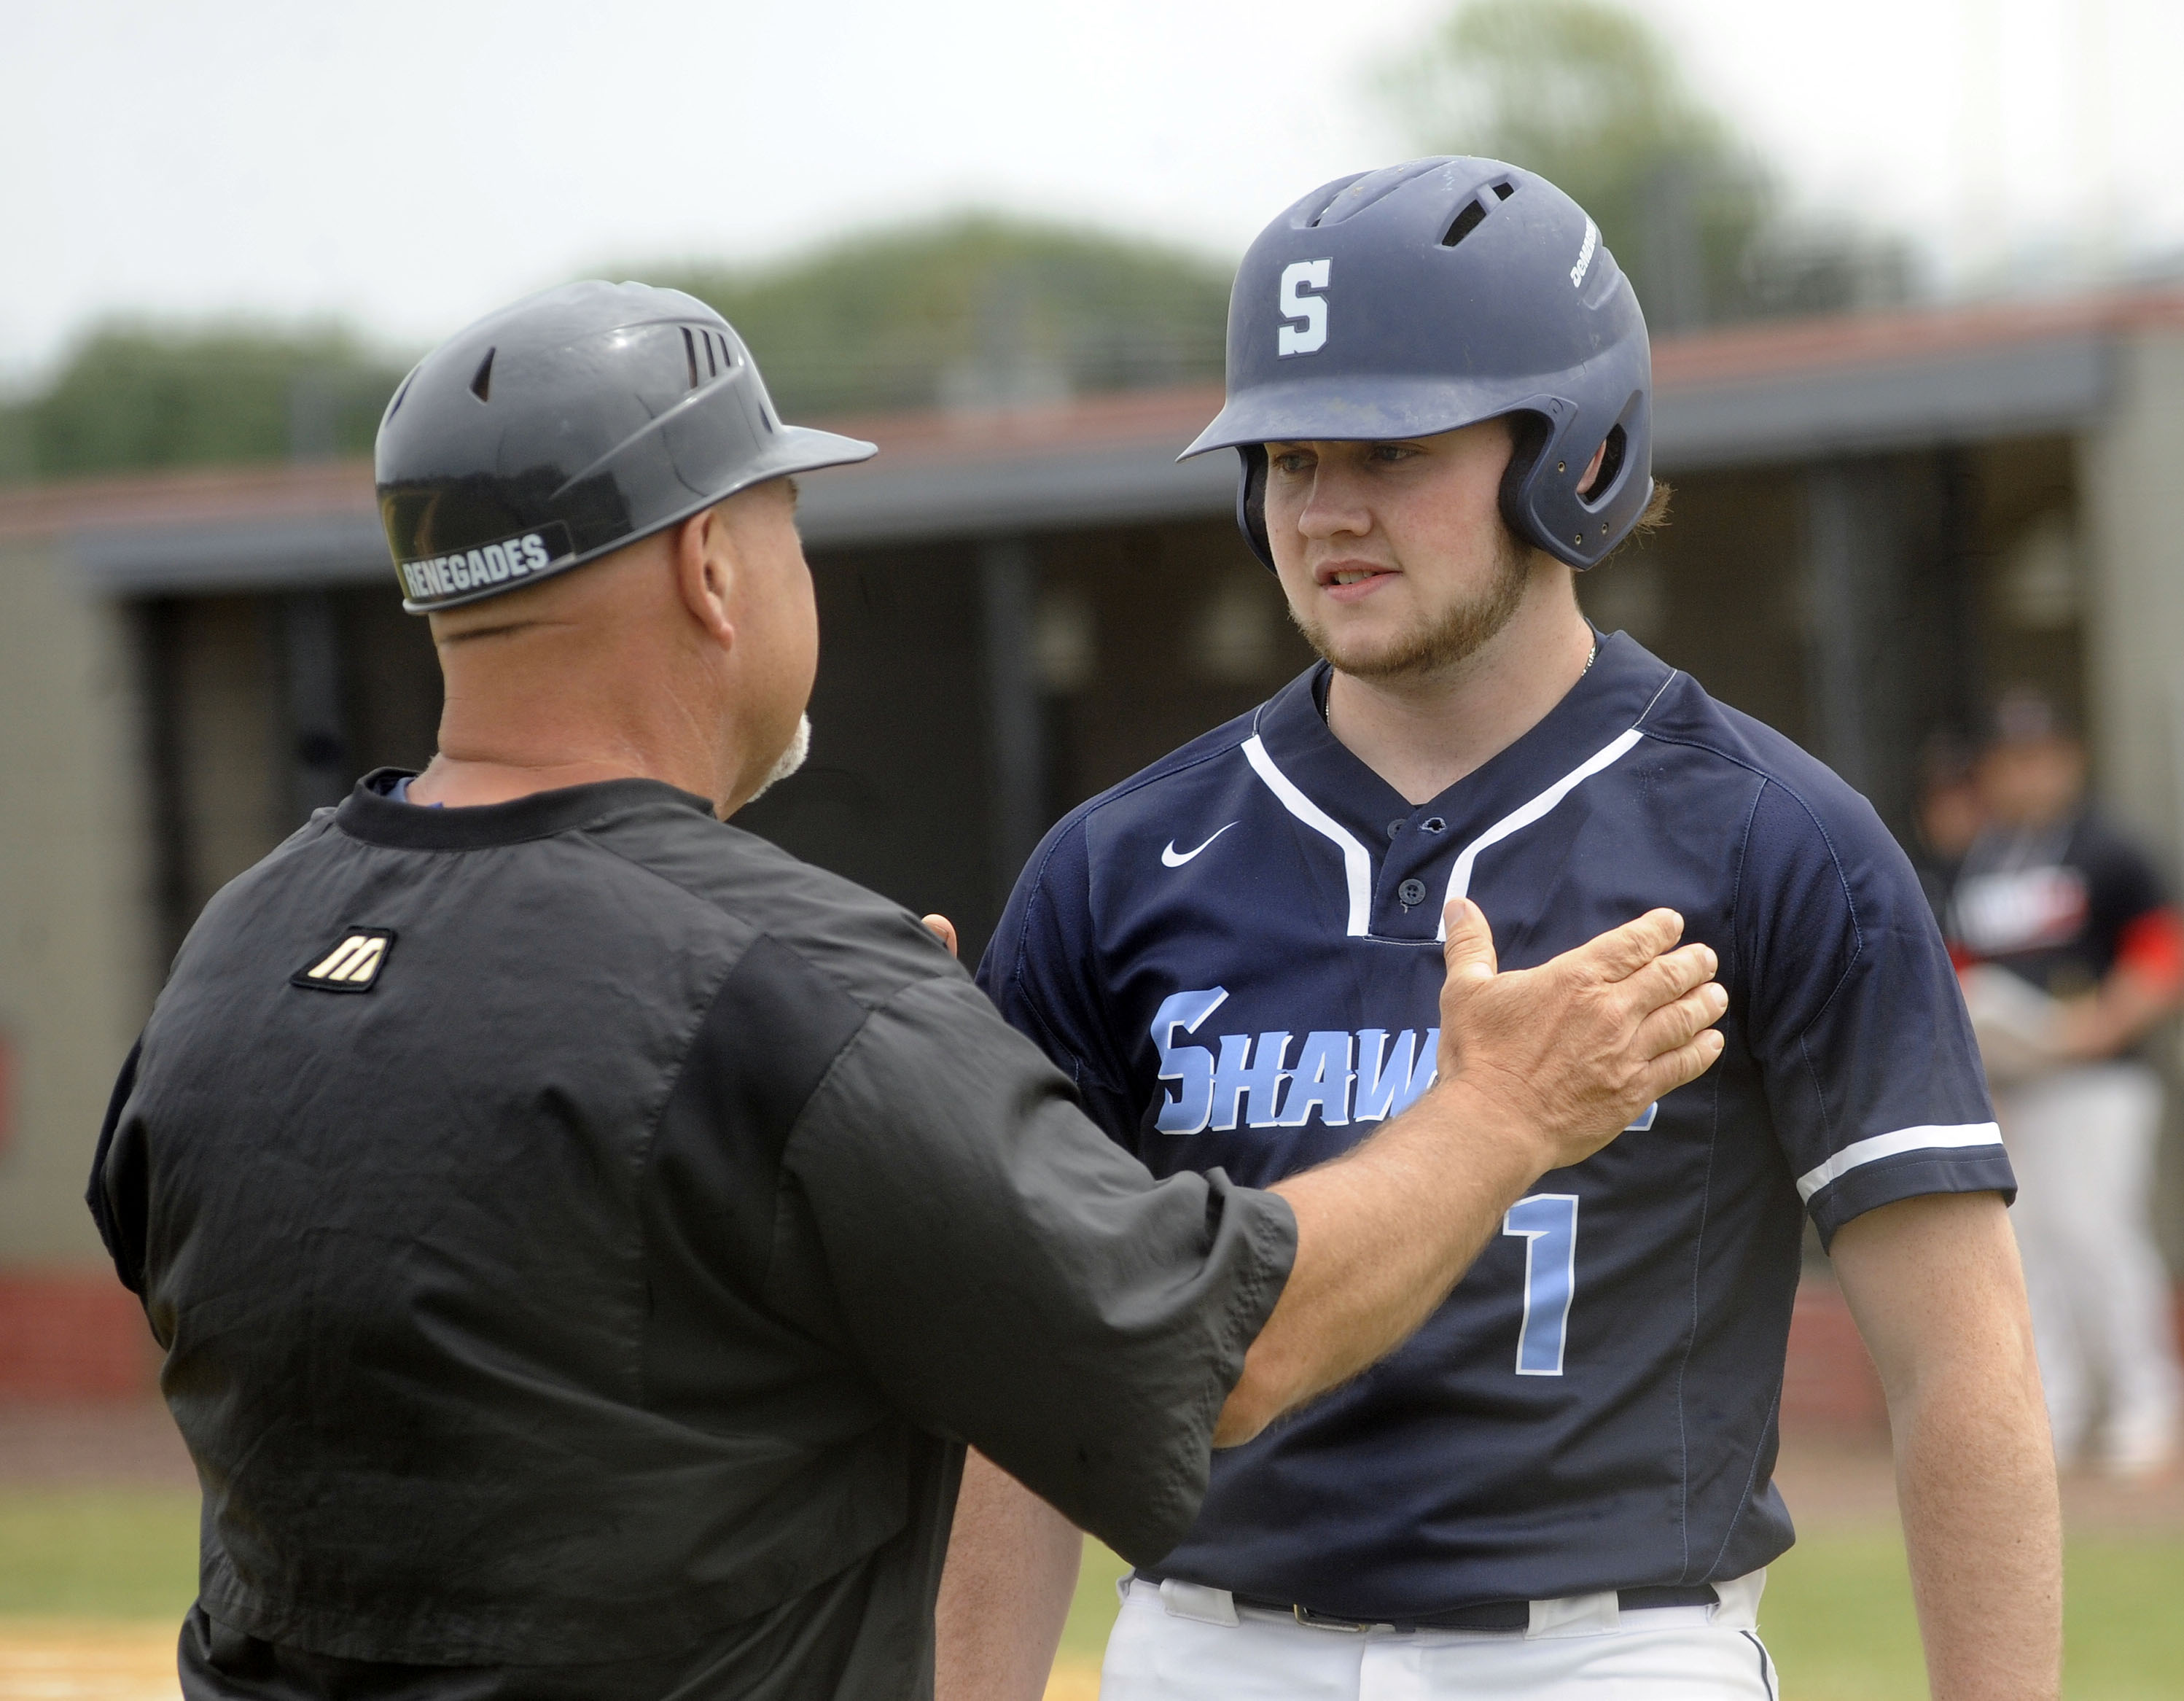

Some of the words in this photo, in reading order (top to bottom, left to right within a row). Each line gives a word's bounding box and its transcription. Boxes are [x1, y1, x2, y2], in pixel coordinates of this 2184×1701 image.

[1278, 258, 1332, 358] S
[402, 533, 549, 598] RENEGADES
[1153, 985, 1658, 1134] SHAW
[1502, 1193, 1579, 1376] 1
